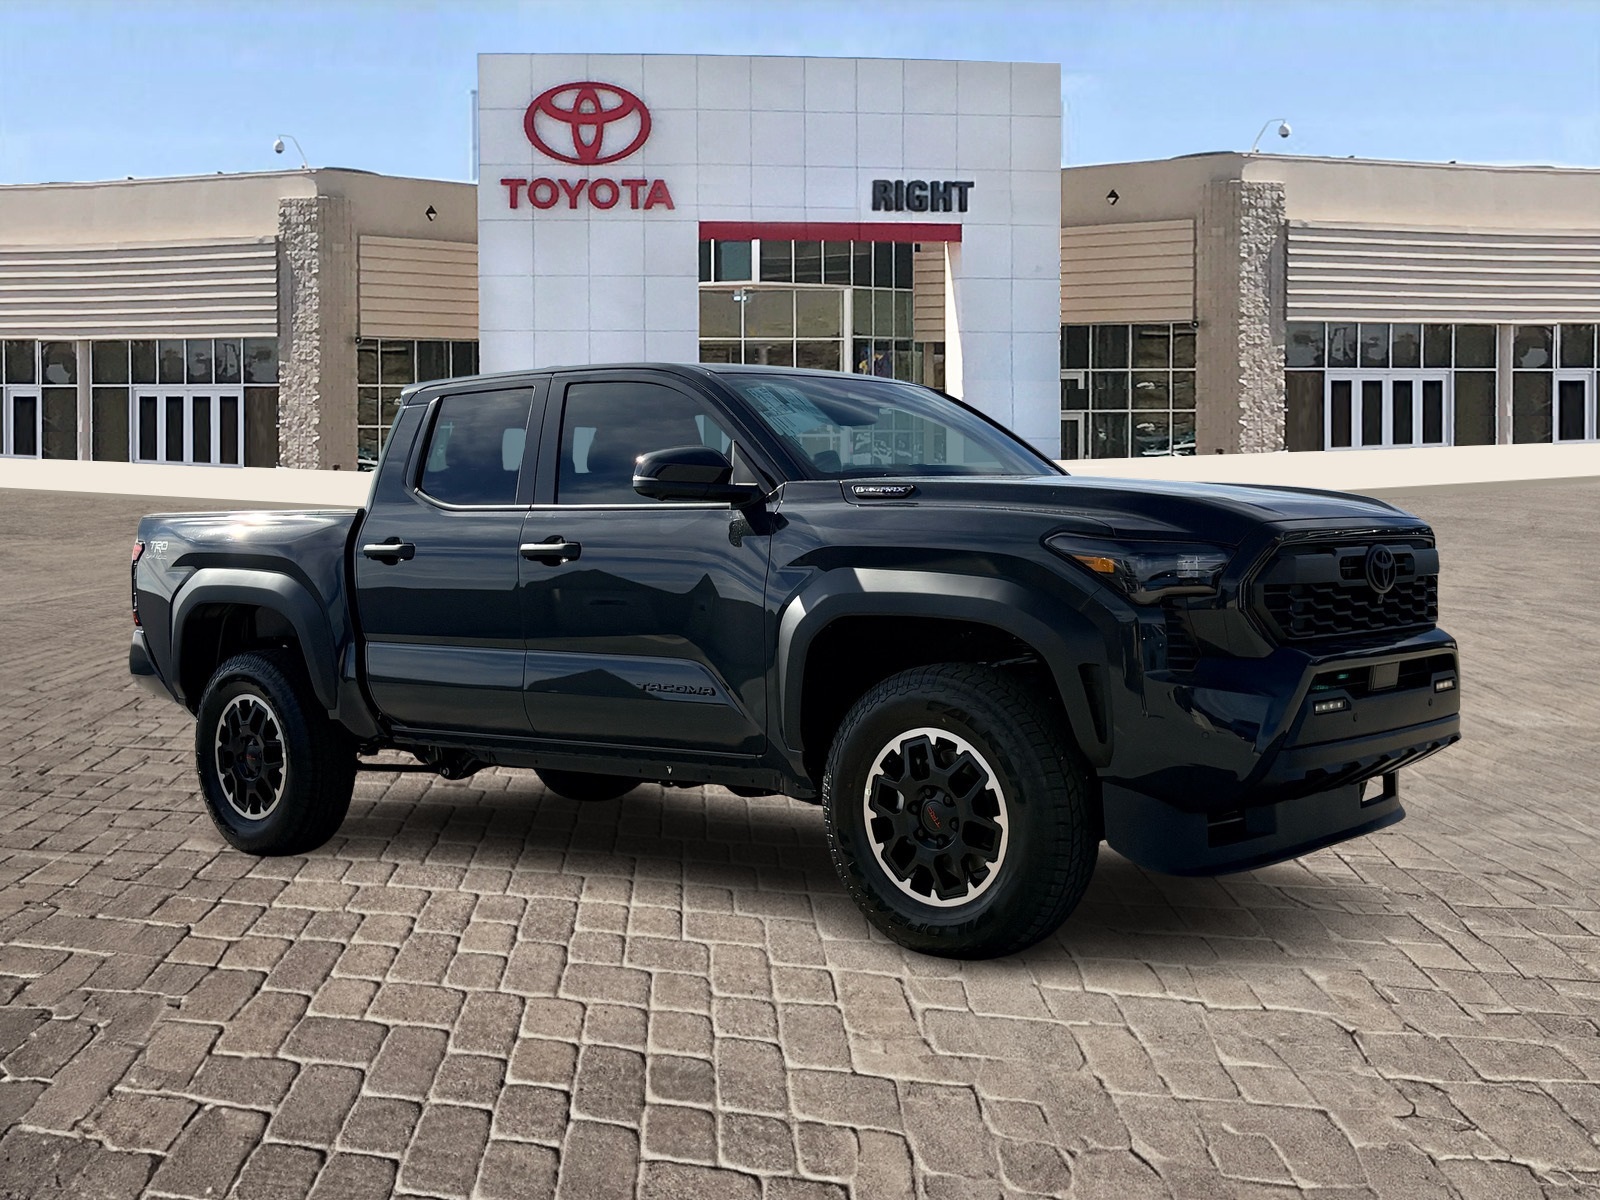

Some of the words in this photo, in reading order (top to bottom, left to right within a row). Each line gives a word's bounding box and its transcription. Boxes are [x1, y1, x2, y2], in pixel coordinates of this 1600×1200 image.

[500, 178, 675, 209] TOYOTA
[872, 180, 975, 212] RIGHT
[150, 541, 168, 554] TRD
[637, 683, 716, 697] TACOMA
